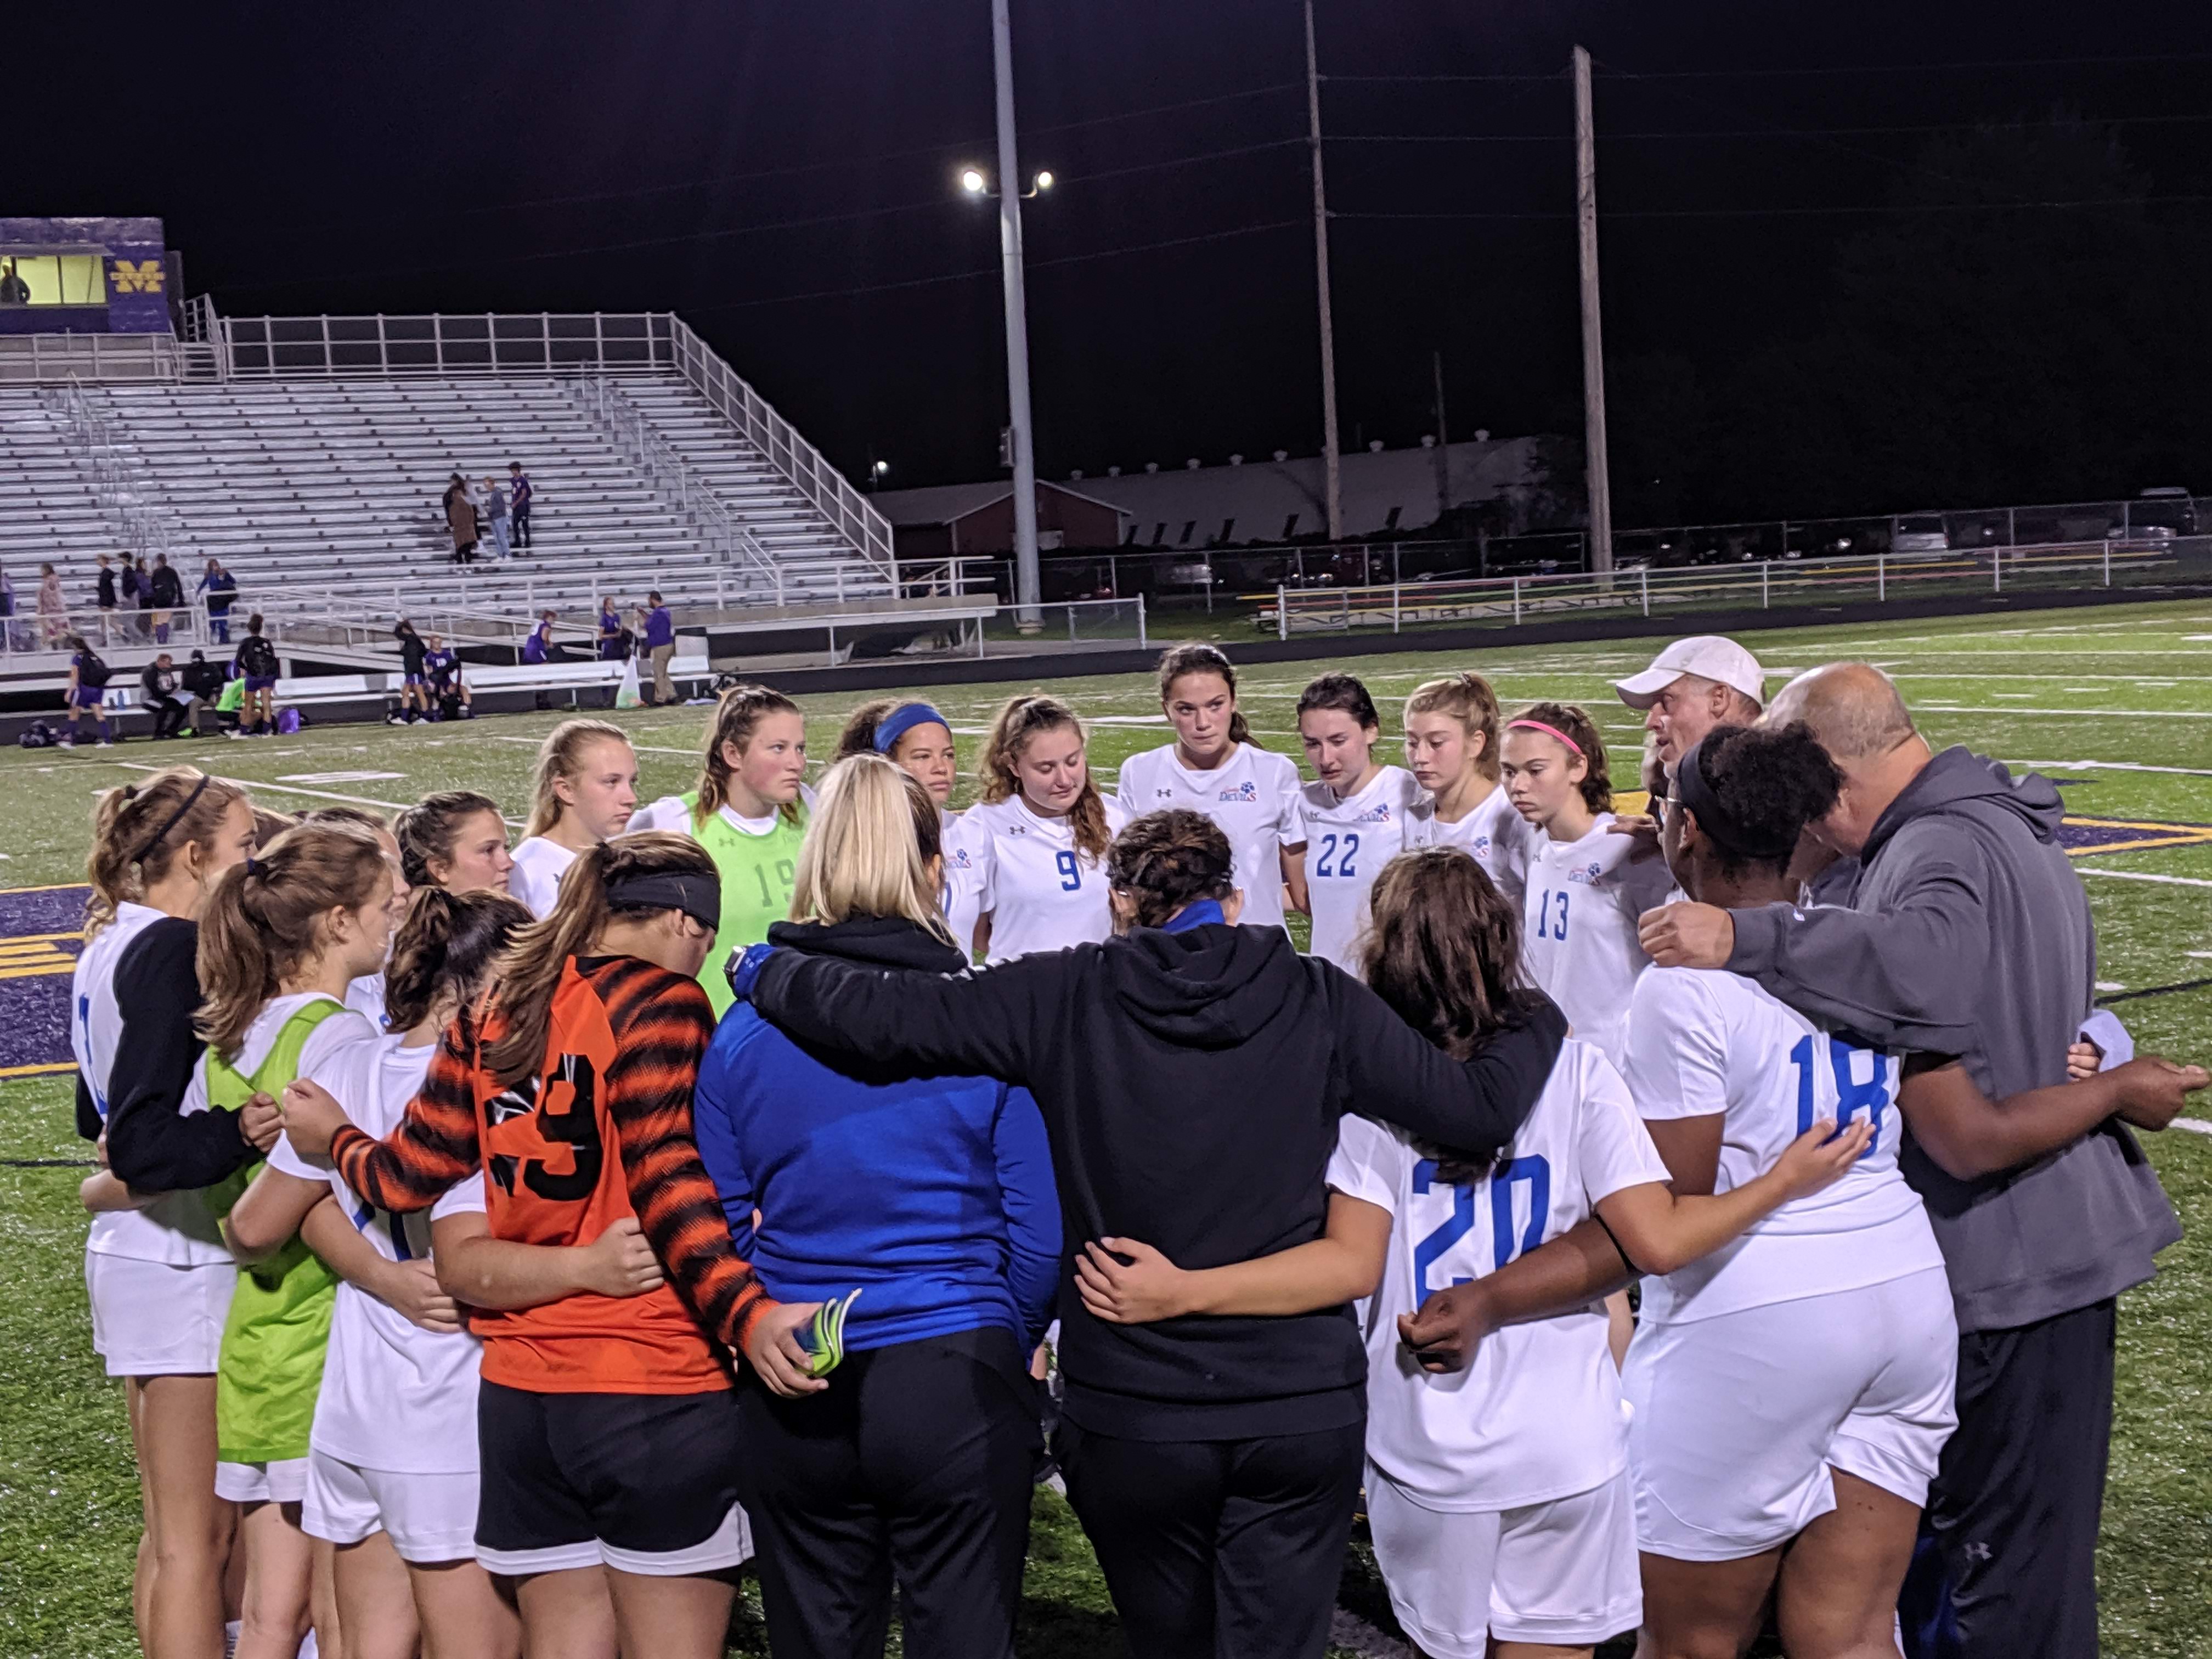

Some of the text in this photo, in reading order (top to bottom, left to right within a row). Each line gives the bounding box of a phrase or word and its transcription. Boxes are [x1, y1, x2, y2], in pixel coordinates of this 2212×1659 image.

[114, 259, 162, 293] M
[1056, 850, 1082, 891] 9
[1317, 834, 1359, 877] 22
[755, 858, 795, 908] 19
[1538, 888, 1569, 941] 13
[1790, 1034, 1889, 1160] 18
[1412, 1153, 1550, 1314] 20
